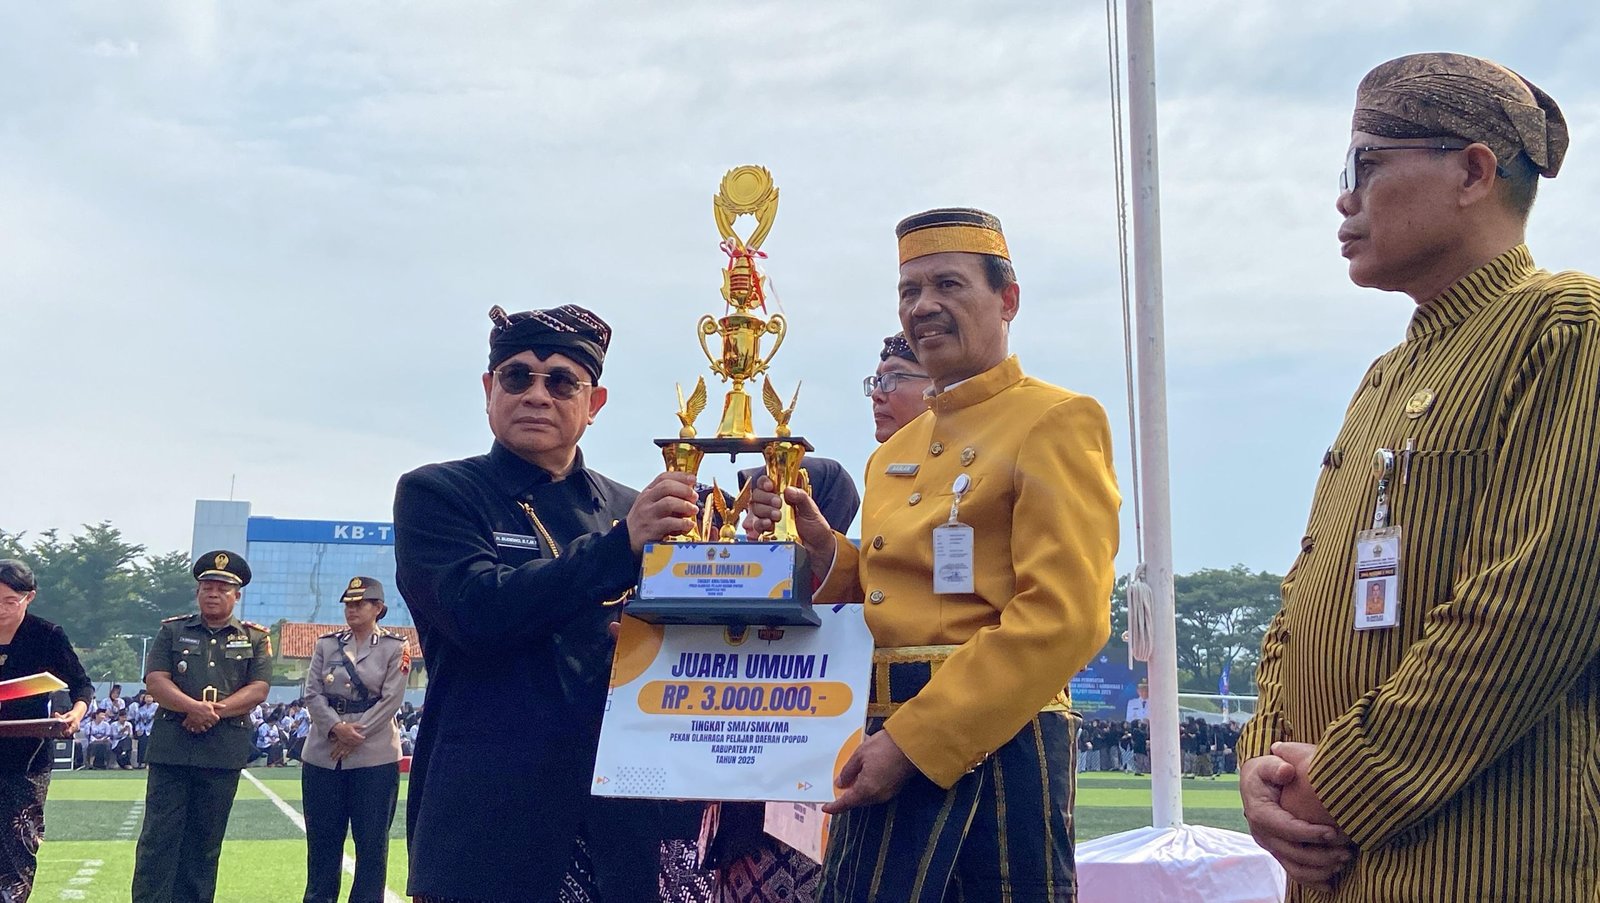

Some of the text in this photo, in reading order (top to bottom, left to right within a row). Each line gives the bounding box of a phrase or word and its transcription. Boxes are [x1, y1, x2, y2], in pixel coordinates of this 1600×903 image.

[684, 564, 713, 576] JUARA
[715, 564, 745, 576] UMUM
[671, 652, 829, 679] JUARA UMUM I
[661, 684, 827, 714] RP. 3.000.000,-
[691, 720, 789, 733] TINGKAT SMA/SMK/MA
[669, 733, 808, 744] PEKAN OLAHRAGA PELAJAR DAERAH (POPDA)
[711, 744, 763, 754] KABUPATEN PATI
[716, 755, 756, 765] TAHUN 2025
